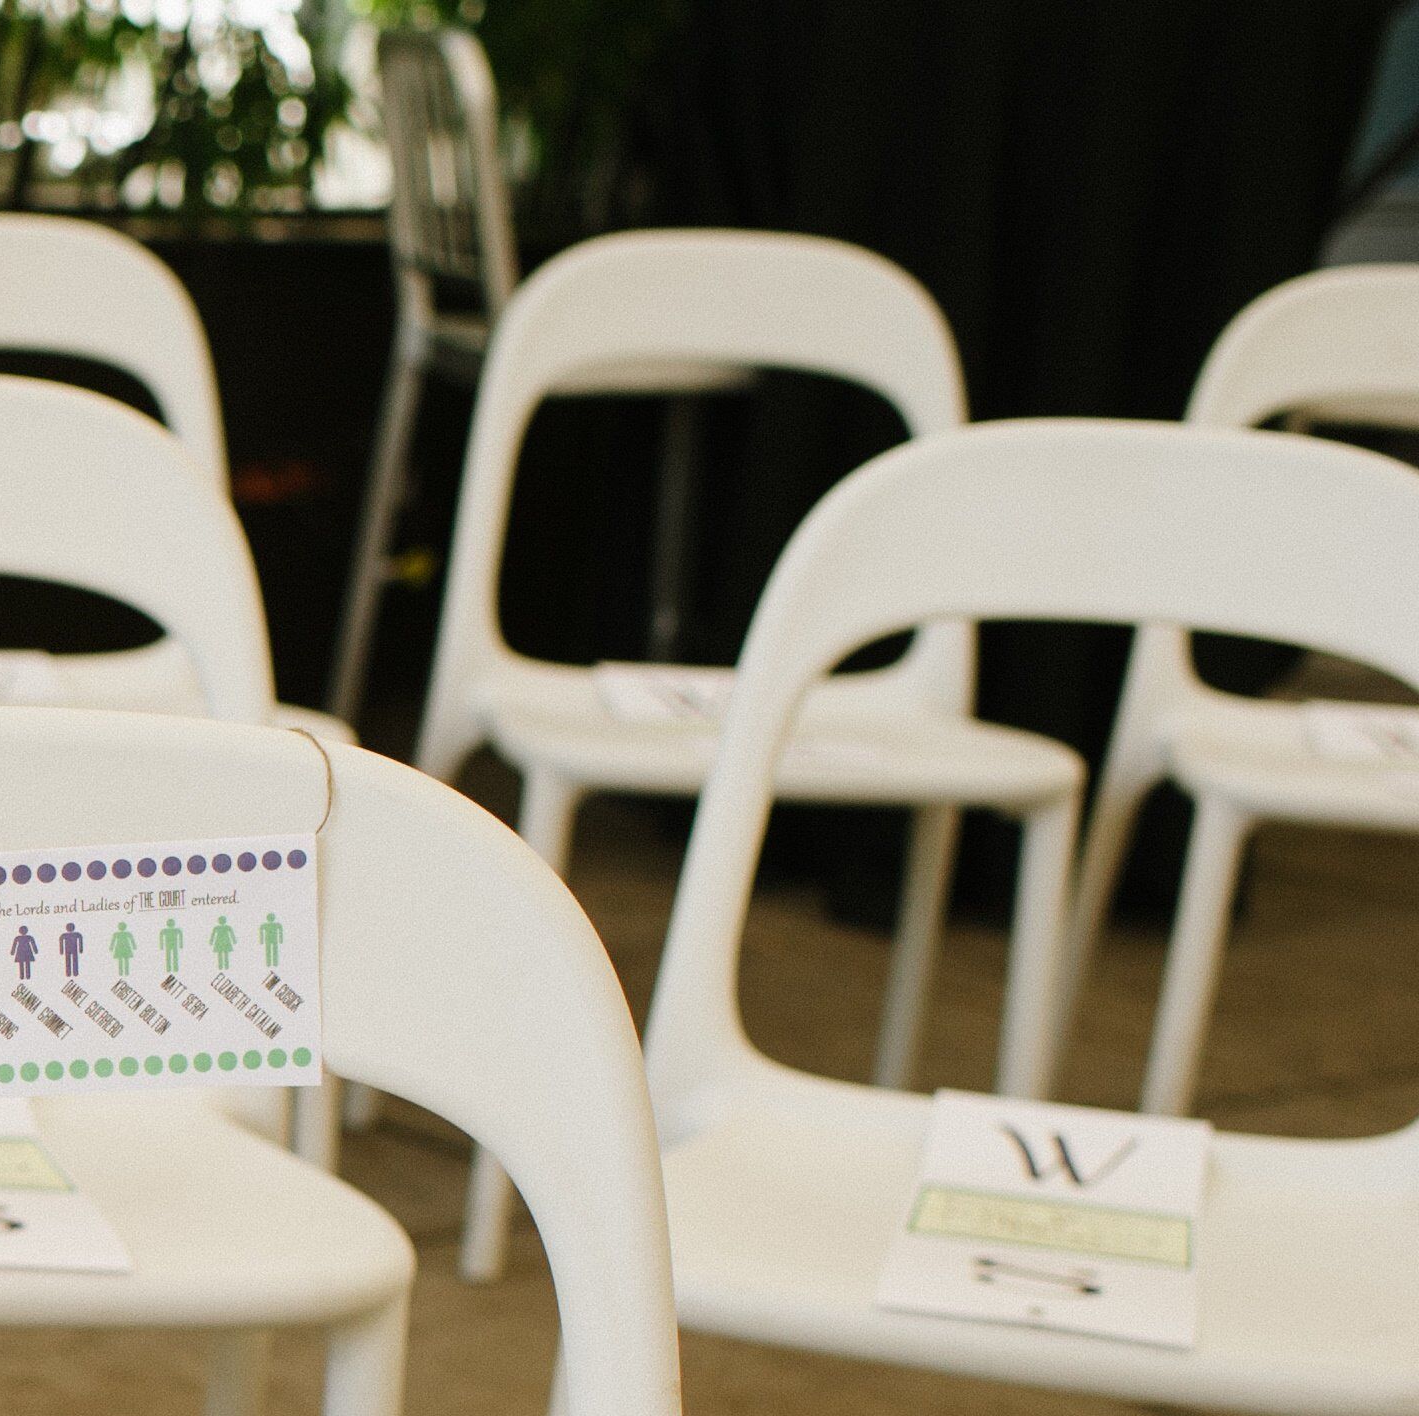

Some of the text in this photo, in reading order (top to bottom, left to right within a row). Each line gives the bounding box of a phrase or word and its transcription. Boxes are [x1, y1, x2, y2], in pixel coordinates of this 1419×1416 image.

[16, 902, 50, 916] Lords
[53, 900, 77, 915] and
[81, 898, 120, 912] Ladies
[123, 894, 138, 915] of
[139, 892, 153, 909] THE
[159, 890, 186, 907] COURT
[191, 890, 240, 905] entered.
[11, 983, 42, 1014] SHANNA
[61, 979, 124, 1039] DANIEL GUERRERO
[111, 978, 171, 1036] KRISTEN BOLTON
[160, 974, 210, 1022] MATT SERPA
[210, 972, 252, 1012] ELIZABETH
[998, 1120, 1137, 1188] W
